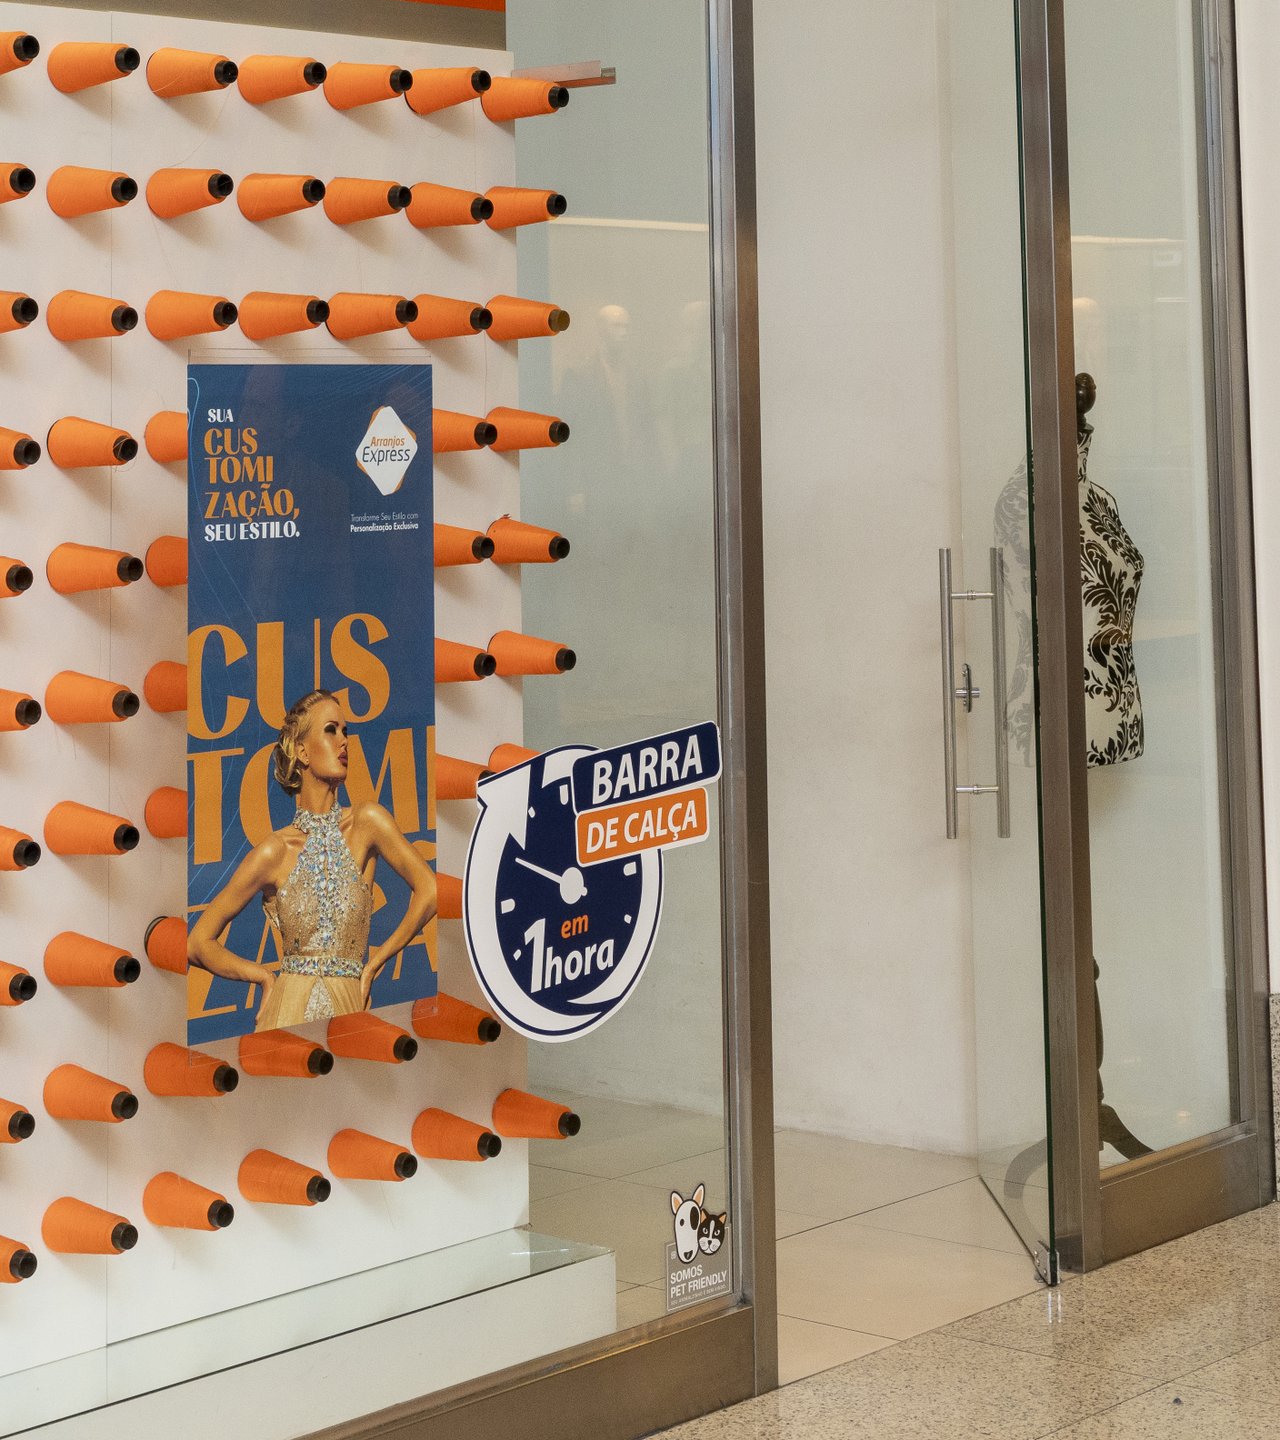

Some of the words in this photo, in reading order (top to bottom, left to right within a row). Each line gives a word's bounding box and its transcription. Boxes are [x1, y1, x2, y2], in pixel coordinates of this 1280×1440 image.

[207, 408, 234, 423] SUA
[204, 427, 259, 456] CUS
[370, 436, 405, 449] Arranjos
[362, 446, 411, 466] Express
[204, 456, 274, 484] TOMI
[204, 484, 300, 525] ZAÇÃO,
[351, 513, 380, 522] Transforme
[392, 512, 406, 520] Estilo
[204, 522, 236, 542] SEU
[239, 520, 300, 540] ESTILO.
[350, 523, 393, 533] Personalização
[393, 522, 419, 530] Exclusiva
[187, 613, 390, 740] CUS
[592, 734, 703, 805] BARRA
[586, 816, 617, 854] DE
[624, 799, 697, 845] CALÇA
[560, 913, 589, 939] em
[670, 1264, 703, 1285] SOMOS
[670, 1283, 687, 1299] PET
[687, 1270, 728, 1293] FRIENDLY
